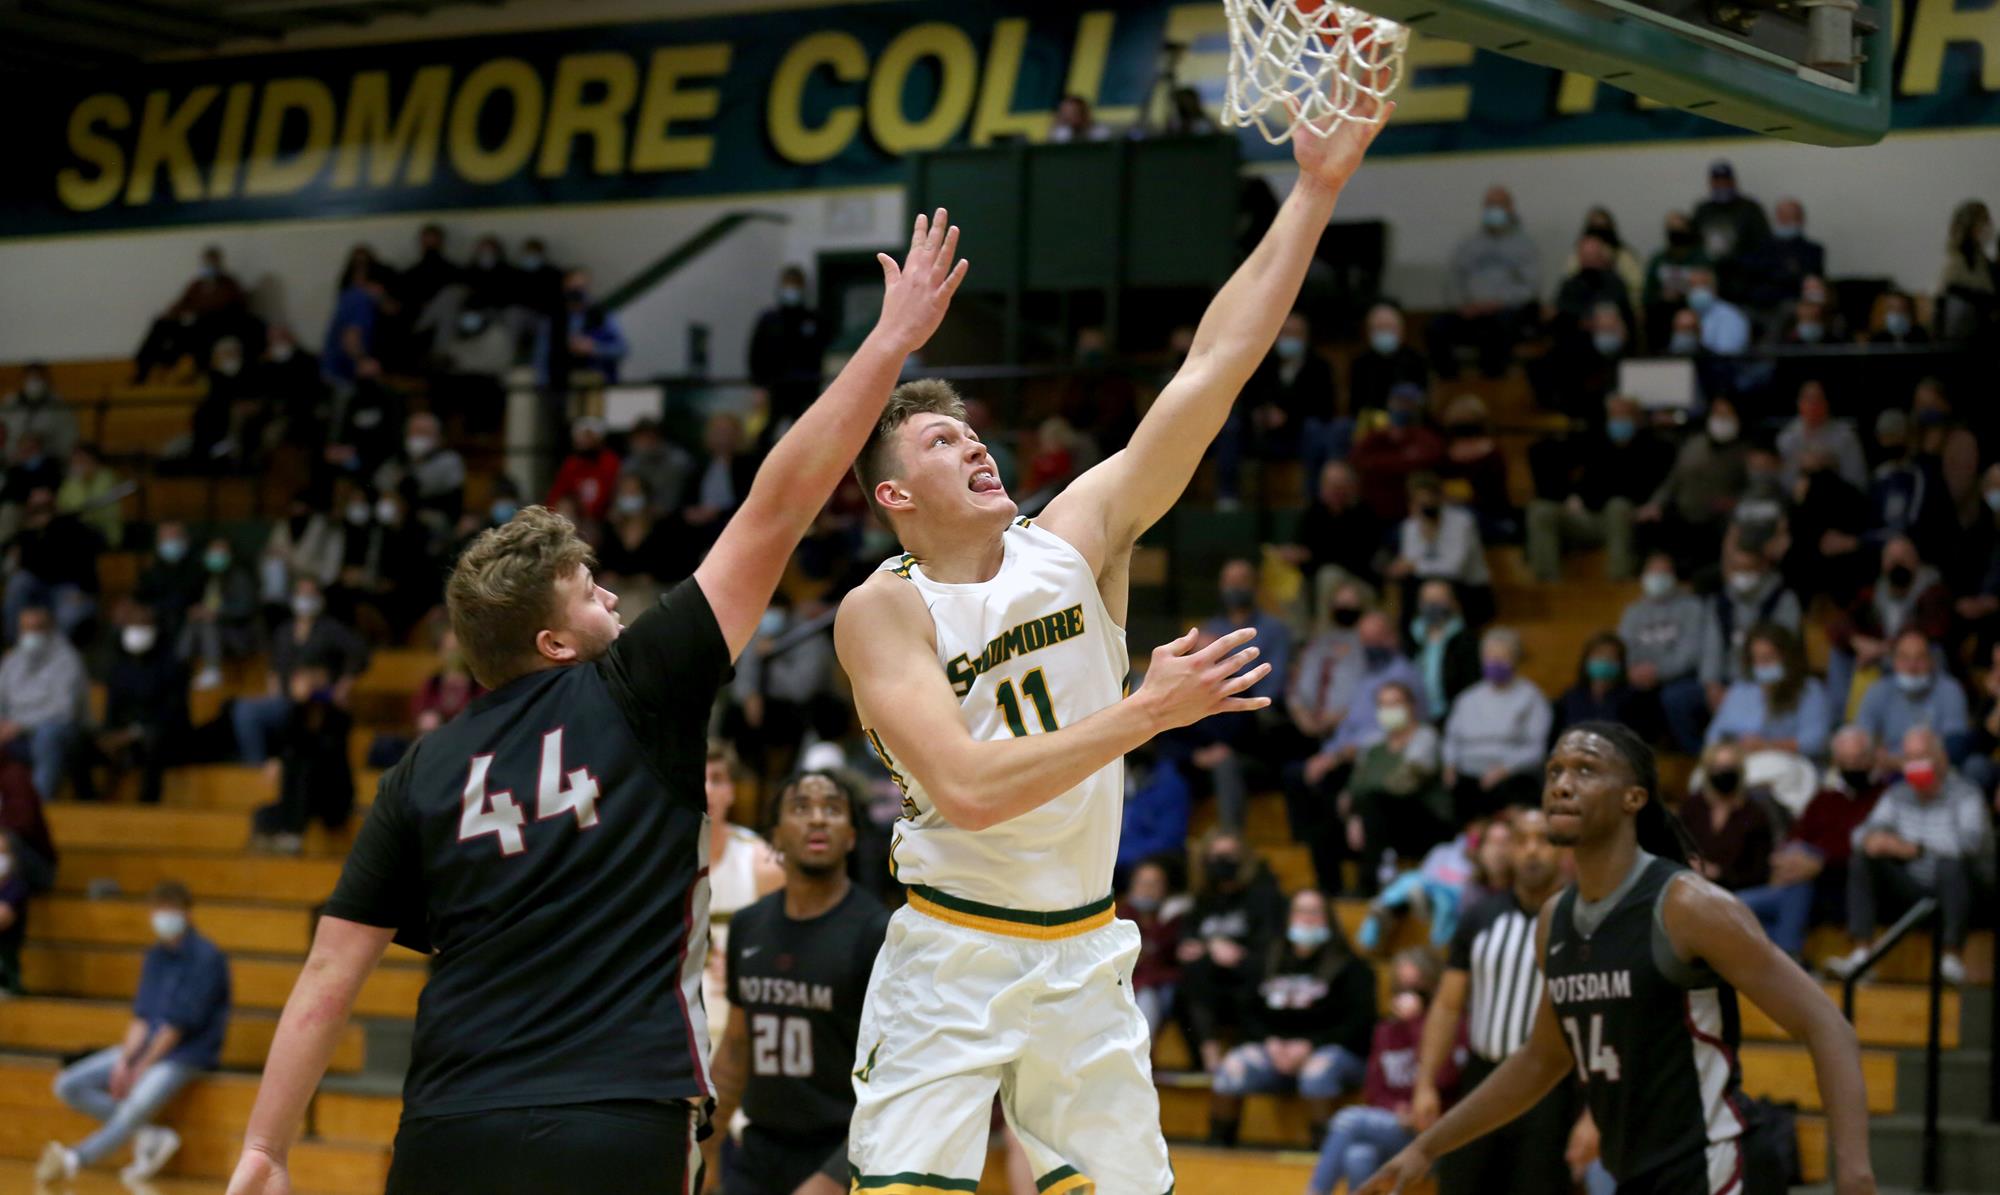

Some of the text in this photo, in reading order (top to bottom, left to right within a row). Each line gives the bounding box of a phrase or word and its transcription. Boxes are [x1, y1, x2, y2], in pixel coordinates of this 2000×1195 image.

[57, 43, 732, 211] SKIDMORE
[995, 666, 1060, 738] 11
[457, 725, 602, 857] 44
[752, 1013, 815, 1077] 20
[1562, 1012, 1622, 1083] 14
